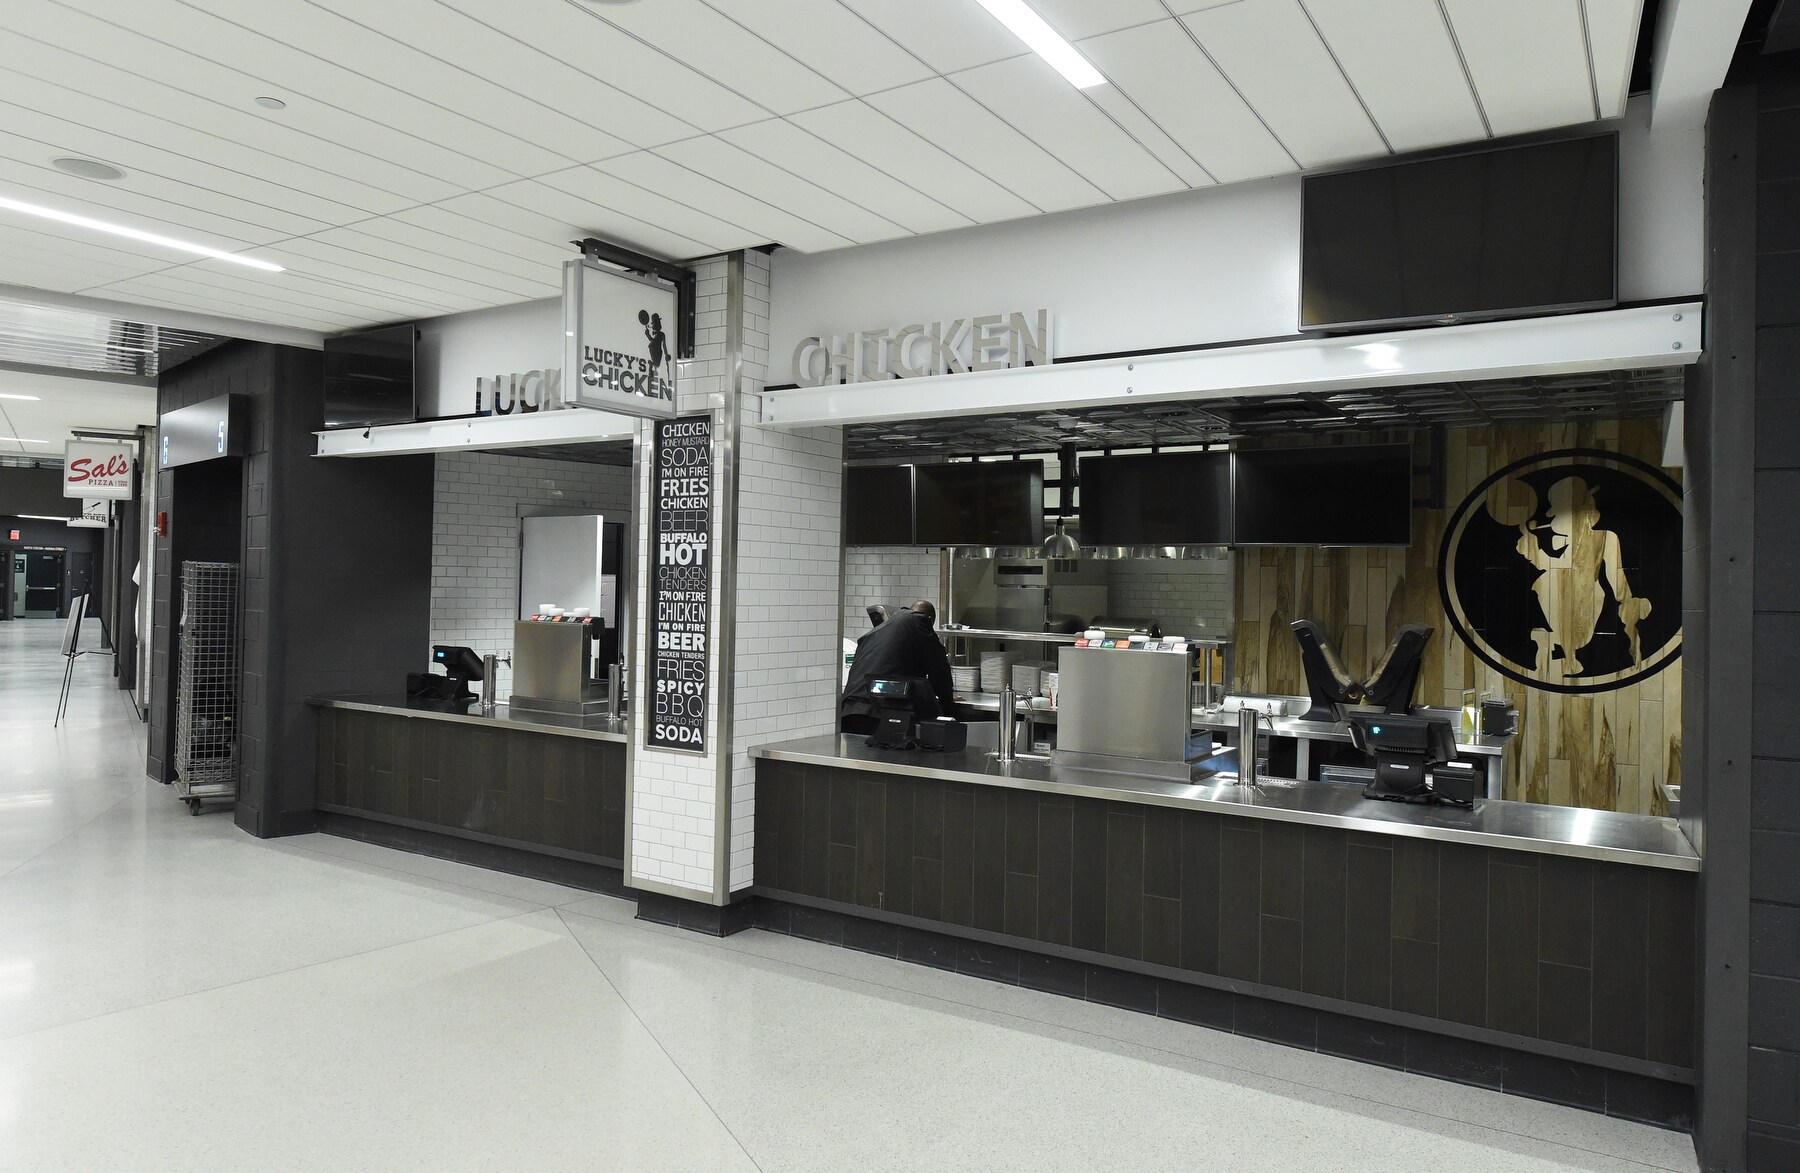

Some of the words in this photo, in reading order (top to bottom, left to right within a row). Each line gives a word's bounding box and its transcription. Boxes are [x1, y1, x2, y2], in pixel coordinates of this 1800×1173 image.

[792, 309, 1051, 388] CHICKEN
[585, 346, 646, 372] LUCKY'S
[582, 363, 672, 401] CHICKEN
[218, 421, 224, 453] 5
[663, 422, 709, 437] CHICKEN
[662, 438, 680, 447] HONEY
[682, 437, 709, 446] MUSTARD
[662, 447, 708, 467] SODA
[68, 454, 129, 482] Sal's
[662, 468, 672, 477] I'M
[674, 468, 686, 477] ON
[689, 466, 708, 476] FIRE
[661, 478, 709, 496] FRIES
[661, 497, 708, 509] CHICKEN
[661, 510, 708, 531] BEER
[660, 532, 707, 543] BUFFALO
[660, 543, 707, 565] HOT
[659, 566, 706, 579] CHICKEN
[660, 579, 706, 590] TENDERS
[659, 591, 671, 600] I'M
[673, 591, 684, 601] ON
[686, 592, 706, 601] FIRE
[659, 602, 706, 622] CHICKEN
[659, 622, 669, 630] I'M
[658, 632, 705, 651] BEER
[657, 659, 704, 681] FRIES
[657, 680, 704, 695] SPICY
[656, 715, 686, 725] BUFFALO
[656, 724, 702, 744] SODA
